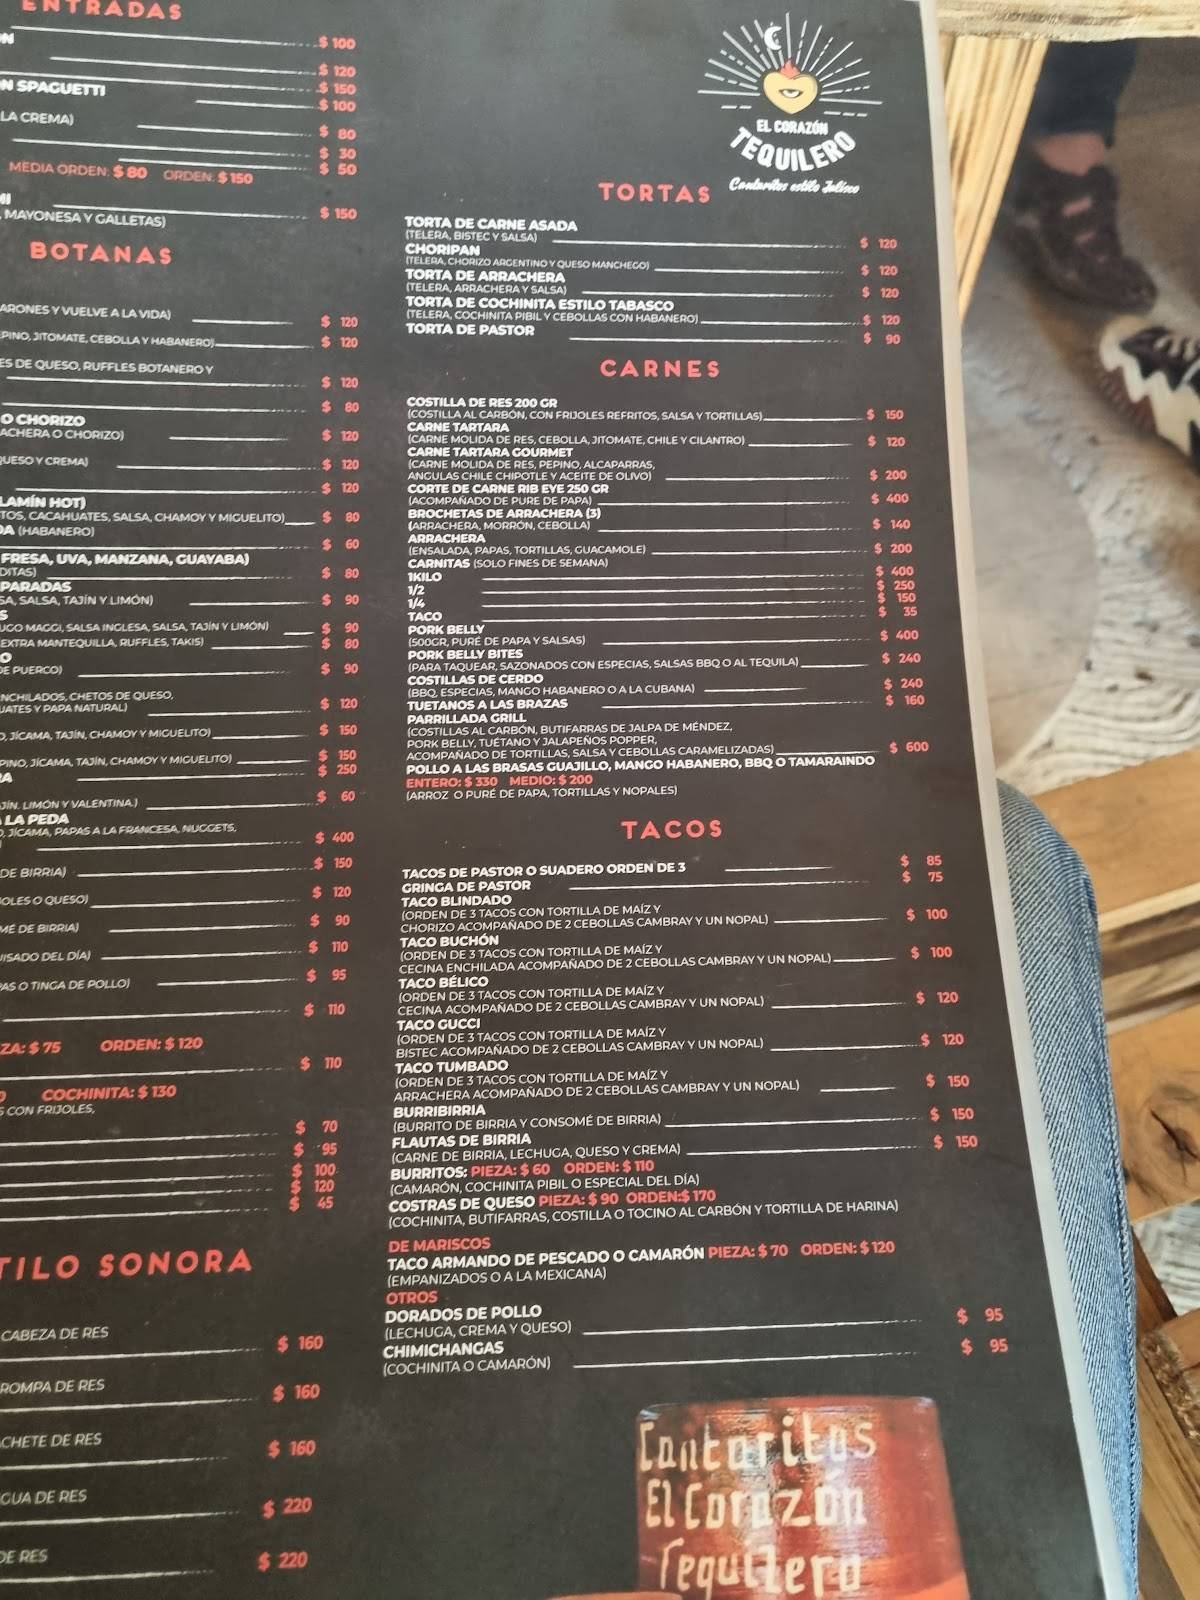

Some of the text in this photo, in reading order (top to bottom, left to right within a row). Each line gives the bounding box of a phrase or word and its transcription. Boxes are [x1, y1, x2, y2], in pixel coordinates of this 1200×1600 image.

[22, 0, 182, 21] ENTRADAS
[319, 36, 356, 50] $ 100
[17, 80, 106, 97] SPAGUETTI
[20, 112, 74, 126] CREMA)
[756, 119, 829, 136] EL CORAZÓN
[730, 126, 856, 172] TEQUILERO
[9, 161, 254, 185] MEDIA ORDEN: $ 80 ORDEN: $ 150
[598, 182, 710, 203] TORTAS
[4, 209, 166, 229] MAYONESA Y GALLETAS)
[404, 216, 578, 232] TORTA DE CARNE ASADA
[405, 229, 537, 243] (TELERA, BISTEC Y SALSA)
[860, 237, 898, 250] $ 120
[30, 241, 171, 265] BOTANAS
[405, 242, 480, 256] CHORIPAN
[405, 268, 566, 283] TORTA DE ARRACHERA
[321, 315, 358, 329] $ 120
[406, 323, 535, 336] TORTA DE PASTOR
[600, 359, 719, 378] CARNES
[406, 397, 558, 408] COSTILLA DE RES 200 GR
[0, 413, 86, 427] O CHORIZO
[408, 409, 764, 422] (COSTILLA AL CARBÓN, CON FRIJOLES REFRITOS, SALSA Y TORTILLAS)
[867, 408, 904, 421] $ 150
[407, 421, 510, 433] CARNE TARTARA
[1, 553, 250, 567] FRESA, UVA, MANZANA, GUAYABA)
[408, 558, 608, 569] CARNITAS (SOLO FINES DE SEMANA)
[322, 593, 360, 607] $ 90
[408, 649, 524, 661] PORK BELLY BITES
[882, 652, 921, 665] $ 240
[407, 674, 544, 686] COSTILLAS DE CERDO
[407, 713, 527, 725] PARRILLADA GRILL
[318, 763, 357, 778] $ 250
[406, 774, 593, 789] ENTERO: $ 330 MEDIO: $ 200
[621, 819, 722, 840] TACOS
[401, 894, 512, 908] TACO BLINDADO
[396, 1018, 480, 1031] TACO GUCCI
[100, 1037, 204, 1052] ORDEN: $ 120
[921, 1033, 965, 1048] $ 120
[42, 1085, 177, 1102] COCHINITA: $ 130
[393, 1104, 486, 1119] BURRIBIRRIA
[930, 1107, 974, 1122] $ 150
[393, 1113, 661, 1134] (BURRITO DE BIRRIA Y CONSOMÉ DE BIRRIA)
[392, 1133, 532, 1149] FLAUTAS DE BIRRIA
[390, 1159, 655, 1181] BURRITOS: PIEZA: $ 60 ORDEN: $ 110
[389, 1237, 491, 1253] DE MARISCOS
[100, 1249, 252, 1277] SONORA
[386, 1290, 438, 1305] OTROS
[385, 1304, 542, 1324] DORADOS DE POLLO
[957, 1307, 1004, 1325] $ 95
[1, 1326, 109, 1342] CABEZA DE RES
[277, 1335, 324, 1354] $ 160
[383, 1341, 504, 1359] CHIMICHANGAS
[383, 1355, 551, 1377] (COCHINITA O CAMARÓN)
[258, 1551, 308, 1572] $ 220
